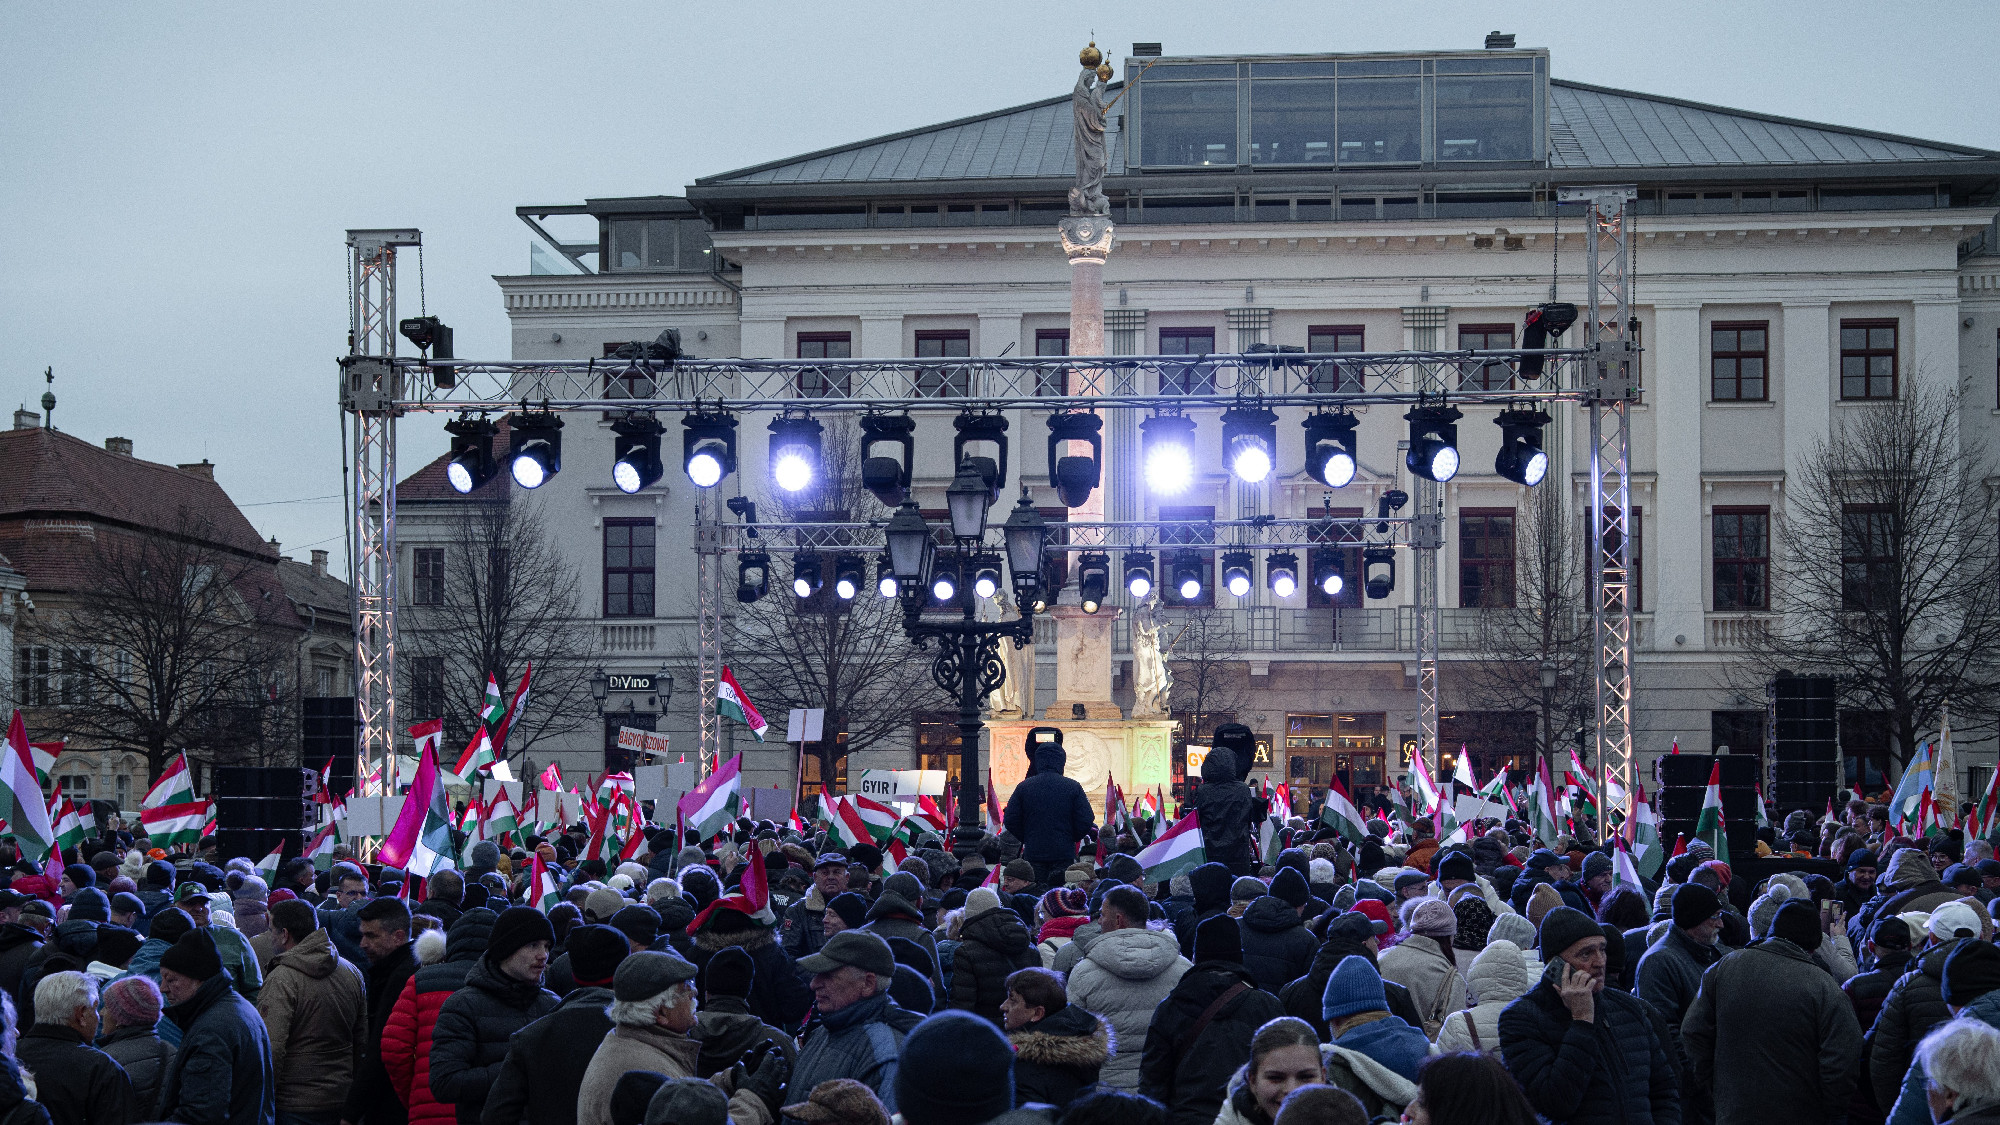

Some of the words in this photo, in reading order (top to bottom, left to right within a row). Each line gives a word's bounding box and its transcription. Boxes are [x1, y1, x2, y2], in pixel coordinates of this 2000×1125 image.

[610, 676, 650, 689] DiVino
[619, 729, 669, 752] BÁGYOSZOVÁT
[1188, 750, 1208, 767] GY
